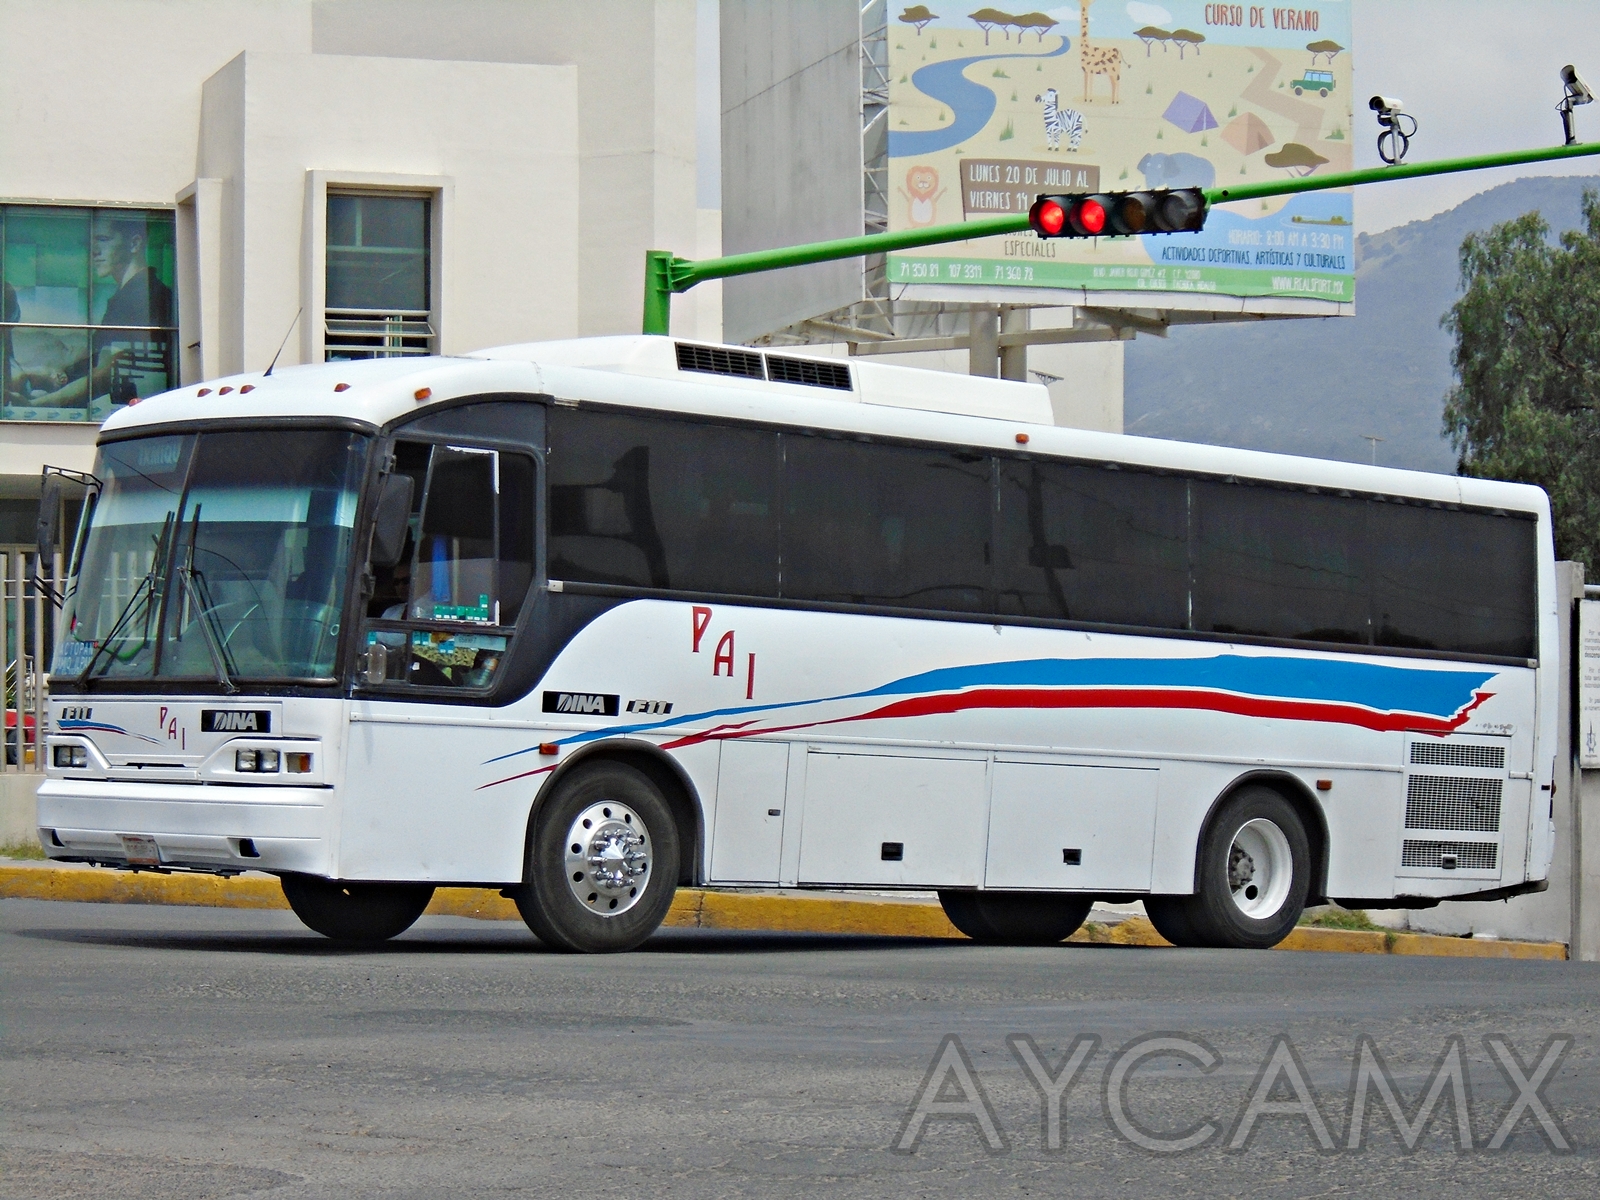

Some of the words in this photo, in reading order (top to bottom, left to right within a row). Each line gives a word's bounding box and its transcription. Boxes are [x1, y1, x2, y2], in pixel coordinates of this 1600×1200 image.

[1205, 3, 1243, 27] CURSO
[1249, 6, 1266, 28] DE
[1273, 7, 1319, 32] VERANO
[970, 164, 1000, 183] LUNES
[1005, 166, 1020, 184] 20
[1025, 167, 1039, 185] DE
[1044, 168, 1071, 187] JULIO
[1076, 170, 1090, 188] AL
[970, 190, 1011, 210] VIERNES
[1016, 192, 1028, 211] 14
[1004, 240, 1056, 258] ESPECIALES
[1266, 230, 1285, 246] 8:00
[1288, 232, 1299, 246] AM
[1302, 232, 1308, 247] A
[1311, 232, 1330, 249] 3:30
[1333, 234, 1344, 250] PM
[1162, 246, 1206, 263] ACTIVIDADES
[1255, 248, 1294, 266] ARTÍSTICAS
[1296, 252, 1302, 266] Y
[1304, 252, 1346, 270] CULTURALES
[900, 262, 910, 277] 71
[912, 263, 927, 277] 350
[948, 264, 961, 278] 107
[995, 265, 1004, 279] 71
[1007, 266, 1021, 280] 360
[1024, 266, 1034, 281] 78
[1272, 276, 1344, 295] WWW.REALSPORT.MX
[556, 693, 606, 714] DINA
[630, 699, 668, 715] F11
[213, 712, 258, 731] DINA
